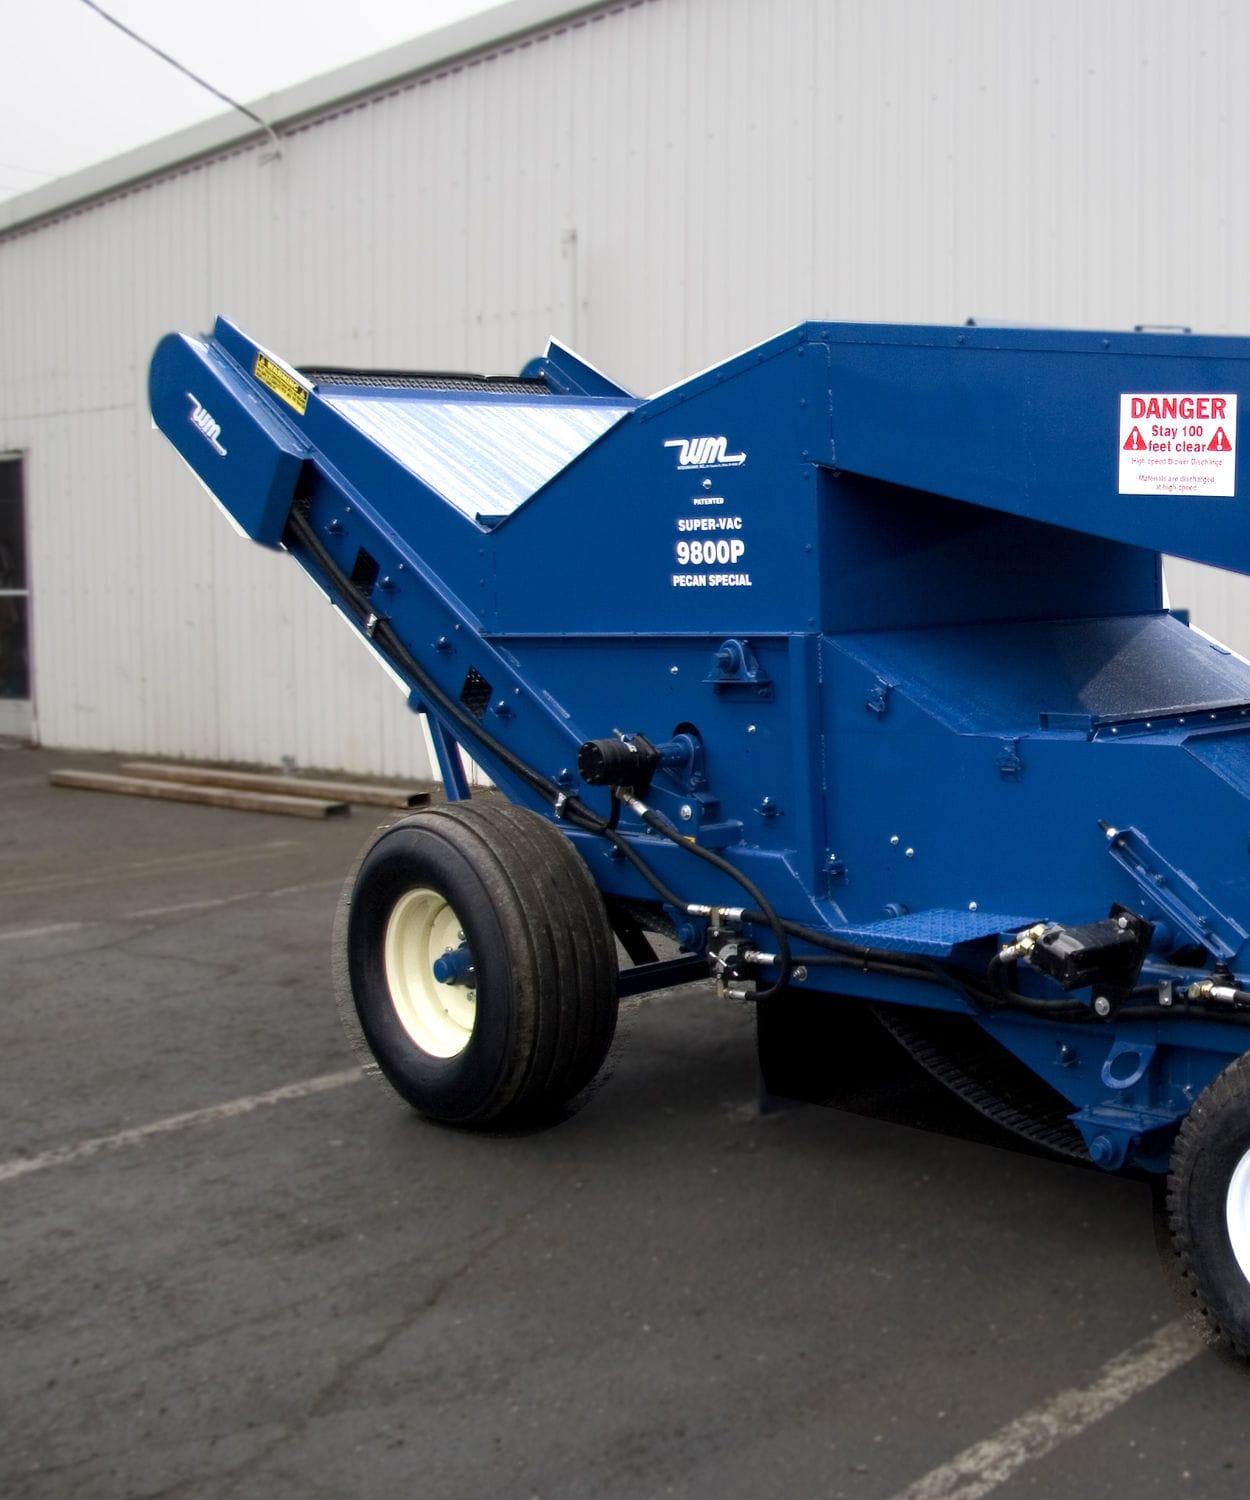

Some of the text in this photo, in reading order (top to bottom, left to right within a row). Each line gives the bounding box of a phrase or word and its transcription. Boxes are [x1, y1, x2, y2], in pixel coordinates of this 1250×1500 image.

[1131, 397, 1227, 419] DANGER
[1151, 424, 1203, 440] Stay 100
[1148, 440, 1207, 453] feet clear
[693, 497, 725, 505] PATENTED
[678, 517, 743, 532] SUPER-VAC
[676, 540, 745, 565] 9800P
[672, 574, 752, 587] PECAN SPECIAL
